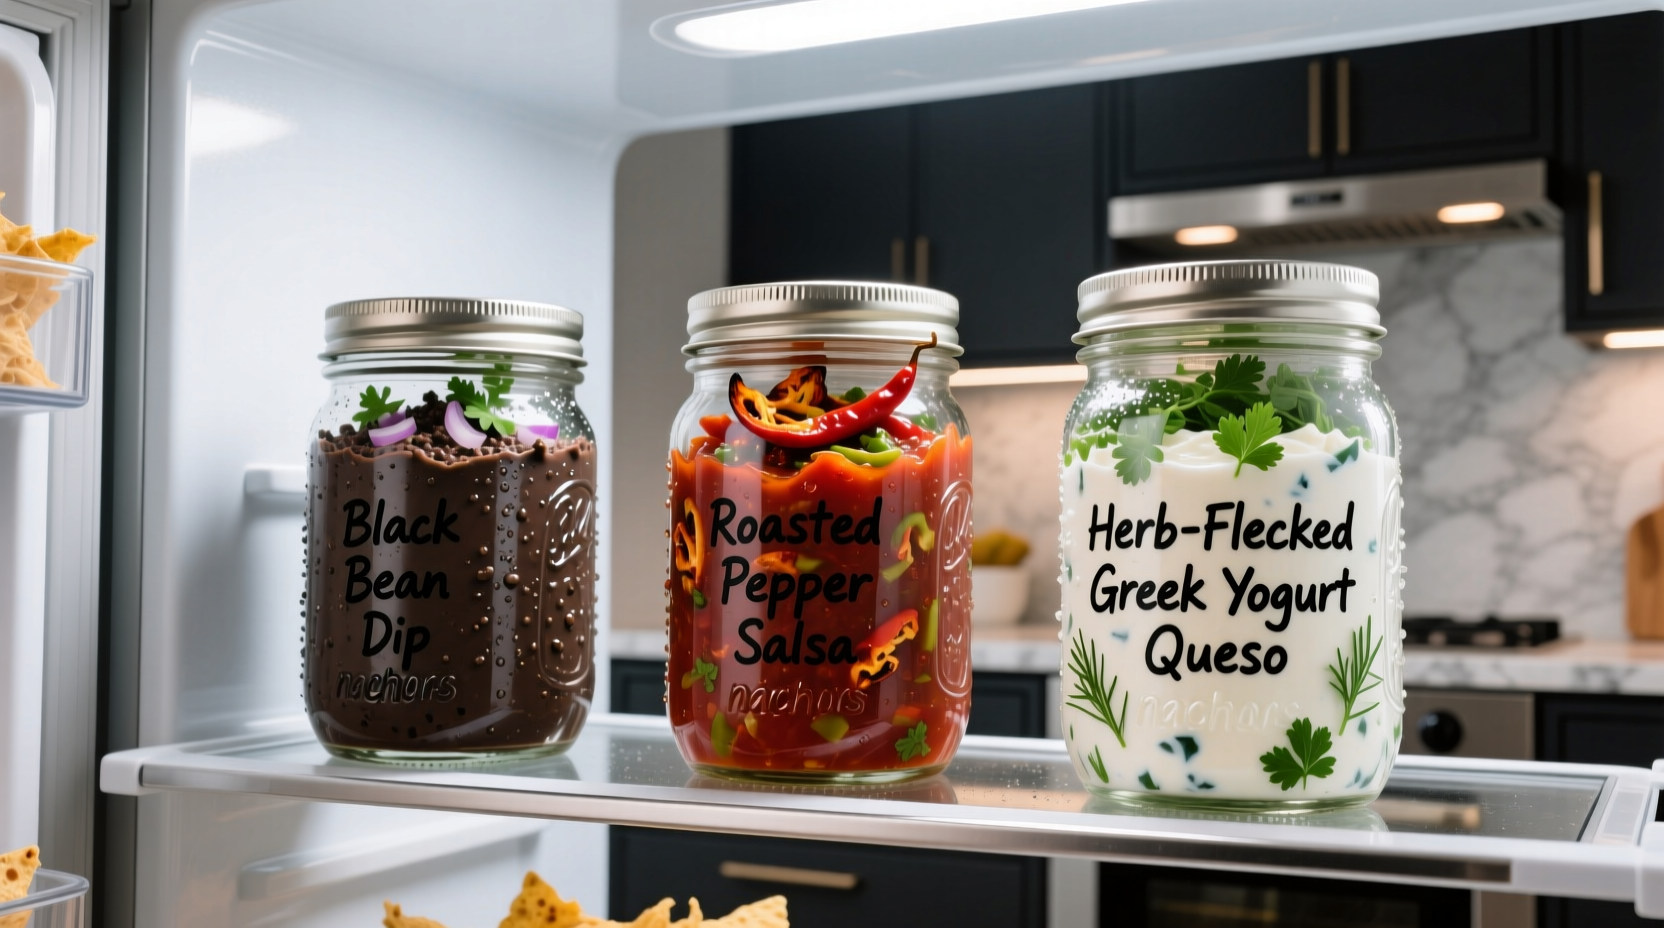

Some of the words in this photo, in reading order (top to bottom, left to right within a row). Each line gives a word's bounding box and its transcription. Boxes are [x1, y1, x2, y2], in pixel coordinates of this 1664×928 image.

[343, 498, 460, 548] Black
[710, 496, 882, 547] Roasted
[1088, 500, 1355, 551] Herb-Flecked
[345, 555, 449, 603] Bean
[721, 556, 873, 620] Pepper
[1090, 563, 1207, 614] Greek
[1222, 566, 1356, 632] Yogurt
[362, 611, 430, 670] Dip
[734, 618, 858, 665] Salsa
[1145, 624, 1288, 681] Queso
